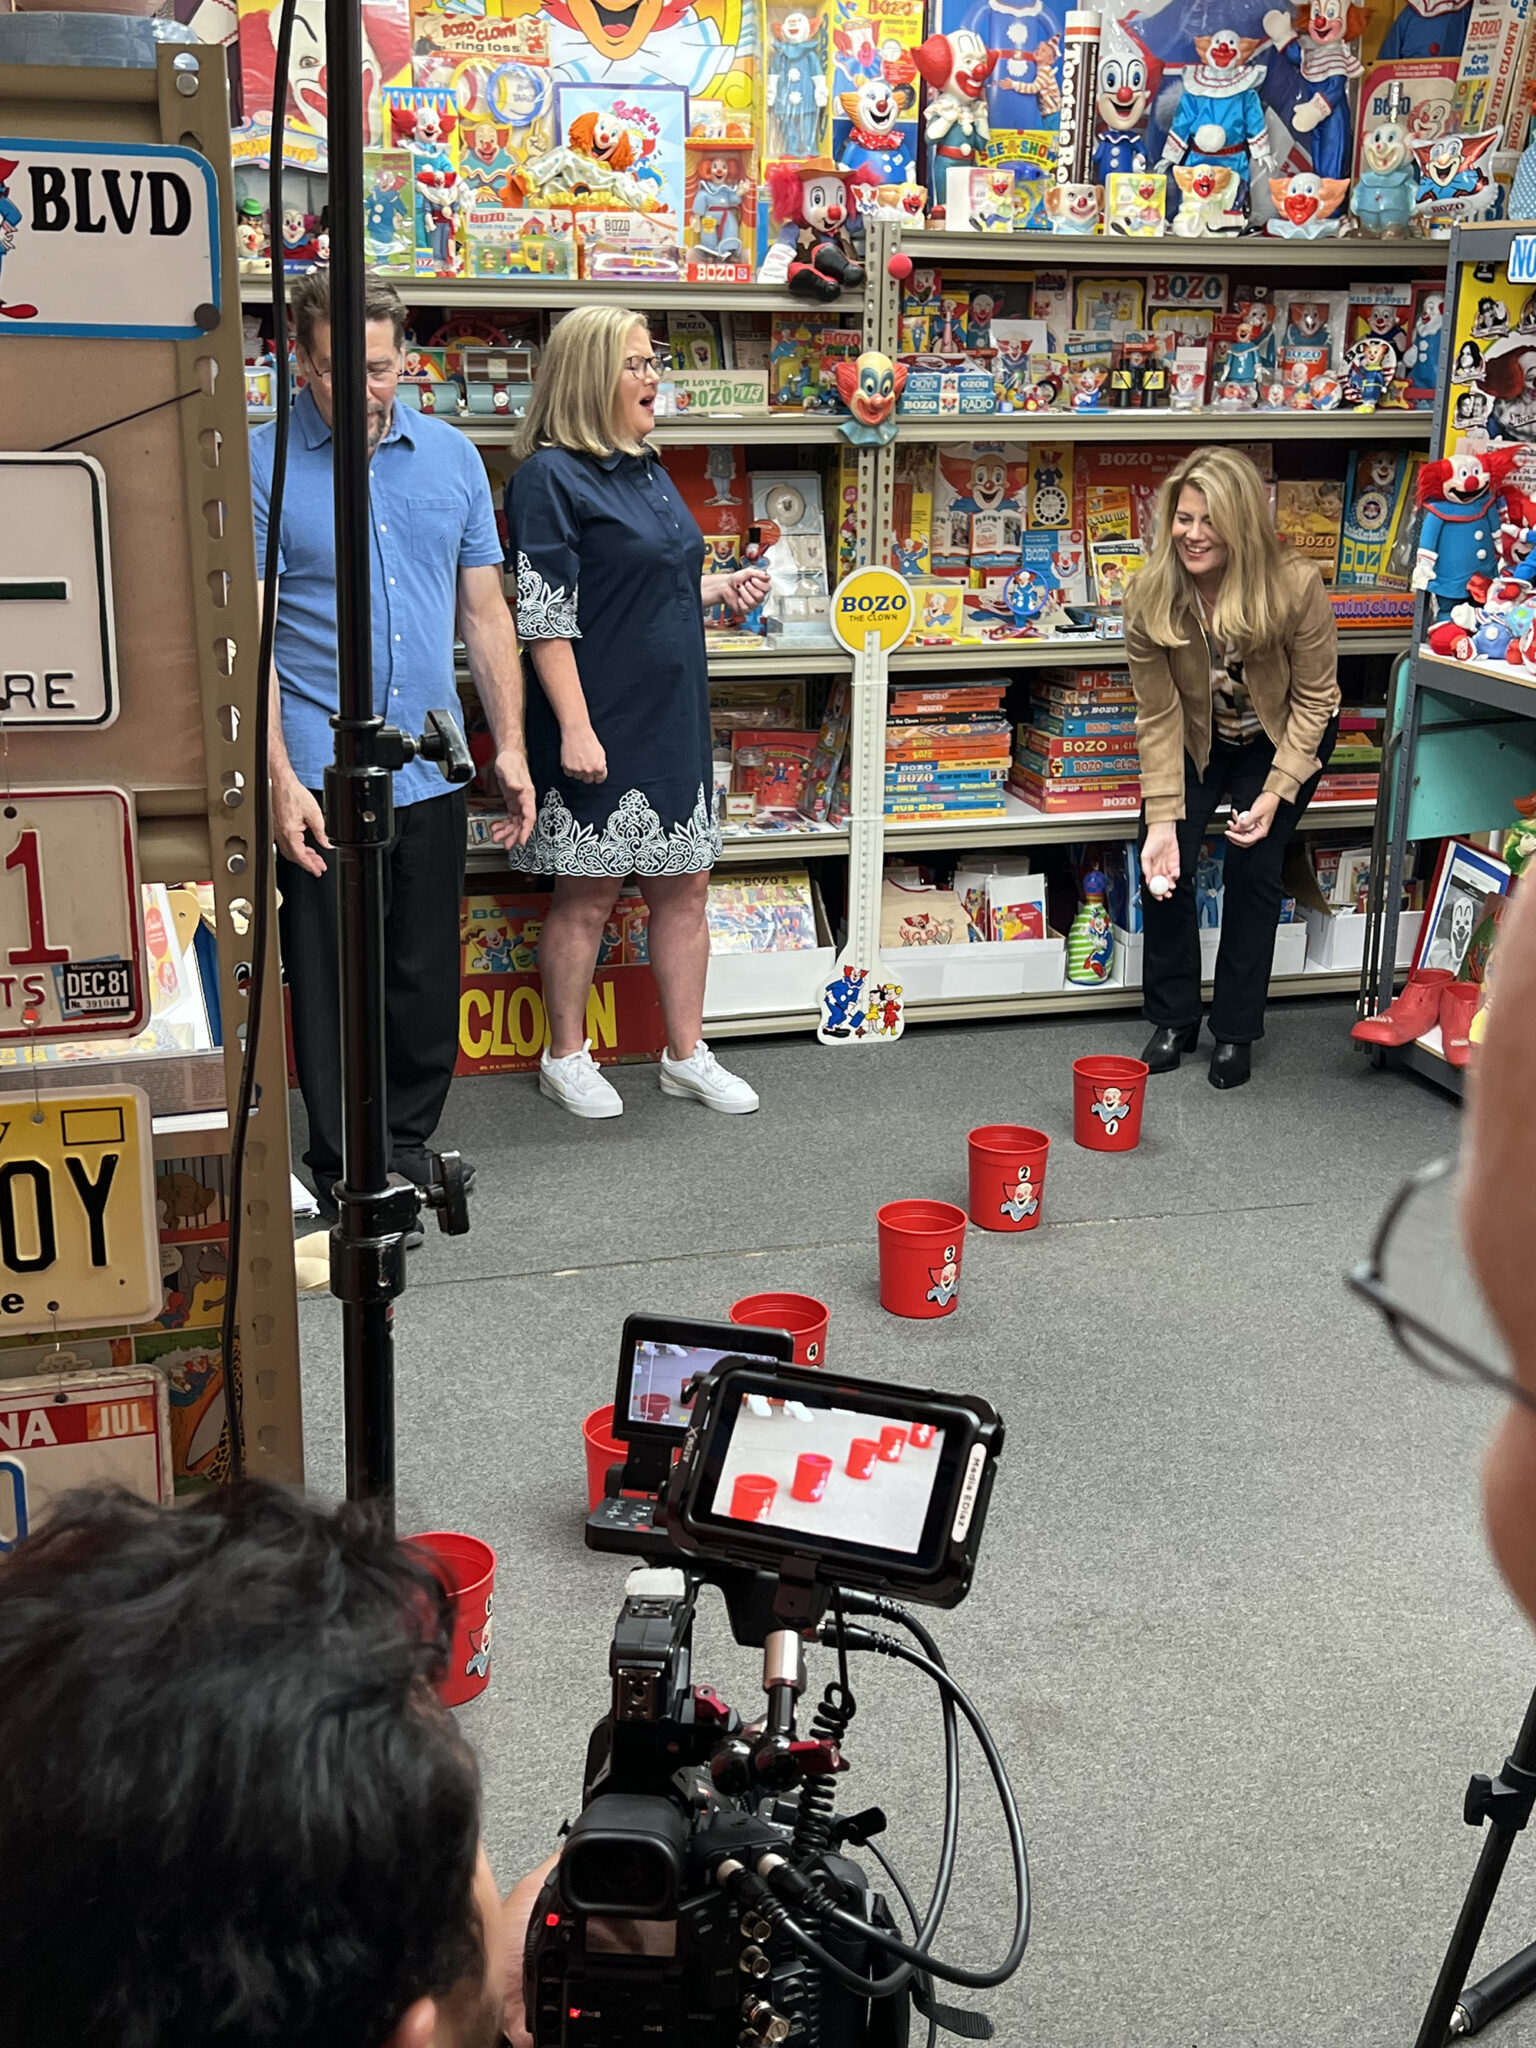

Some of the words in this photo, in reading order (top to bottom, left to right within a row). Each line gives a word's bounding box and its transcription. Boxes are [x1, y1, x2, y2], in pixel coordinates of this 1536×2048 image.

[441, 21, 476, 38] BOZO
[475, 23, 517, 42] CLOWN
[1469, 19, 1502, 36] BOZO
[455, 42, 485, 53] ring
[488, 42, 520, 53] toss
[1471, 54, 1489, 64] Crib
[1491, 78, 1506, 109] THE
[1499, 21, 1520, 75] CLOWN
[1463, 66, 1489, 76] Mobile
[28, 166, 192, 236] BLVD
[1431, 202, 1465, 213] BOZO
[470, 212, 505, 223] BOZO
[605, 219, 630, 231] BOZO
[697, 265, 736, 281] BOZO
[1152, 274, 1223, 300] BOZO
[677, 321, 706, 329] BOZO
[823, 333, 860, 345] BOZO
[692, 379, 721, 387] LOVE
[903, 401, 937, 410] BOZO
[961, 400, 994, 409] RADIO
[1098, 453, 1153, 466] BOZO
[1294, 535, 1336, 548] BOZO
[1025, 549, 1050, 561] BOZO
[1340, 537, 1381, 573] BOZ
[1355, 573, 1375, 585] THE
[841, 595, 907, 612] BOZO
[867, 613, 898, 622] CLOWN
[4, 672, 76, 709] RE
[917, 704, 943, 712] BOZO
[1085, 723, 1110, 733] BOZO
[912, 738, 932, 747] BOZO
[1063, 740, 1107, 752] BOZO
[912, 751, 933, 759] BOZO
[1074, 761, 1102, 772] BOZO
[897, 773, 934, 782] BOZO
[892, 803, 945, 812] RUB-ONS
[1102, 797, 1136, 807] BOZO
[744, 876, 789, 886] BOZO'S
[6, 831, 69, 965] 1
[67, 971, 106, 997] DEC
[108, 970, 129, 995] 81
[0, 975, 45, 1008] TS
[71, 1001, 82, 1009] No.
[459, 981, 618, 1059] CLON
[1109, 1122, 1115, 1133] 1
[1020, 1167, 1029, 1179] 2
[0, 1153, 119, 1273] OY
[946, 1248, 954, 1260] 3
[808, 1344, 817, 1357] 4
[98, 1403, 147, 1438] JUL
